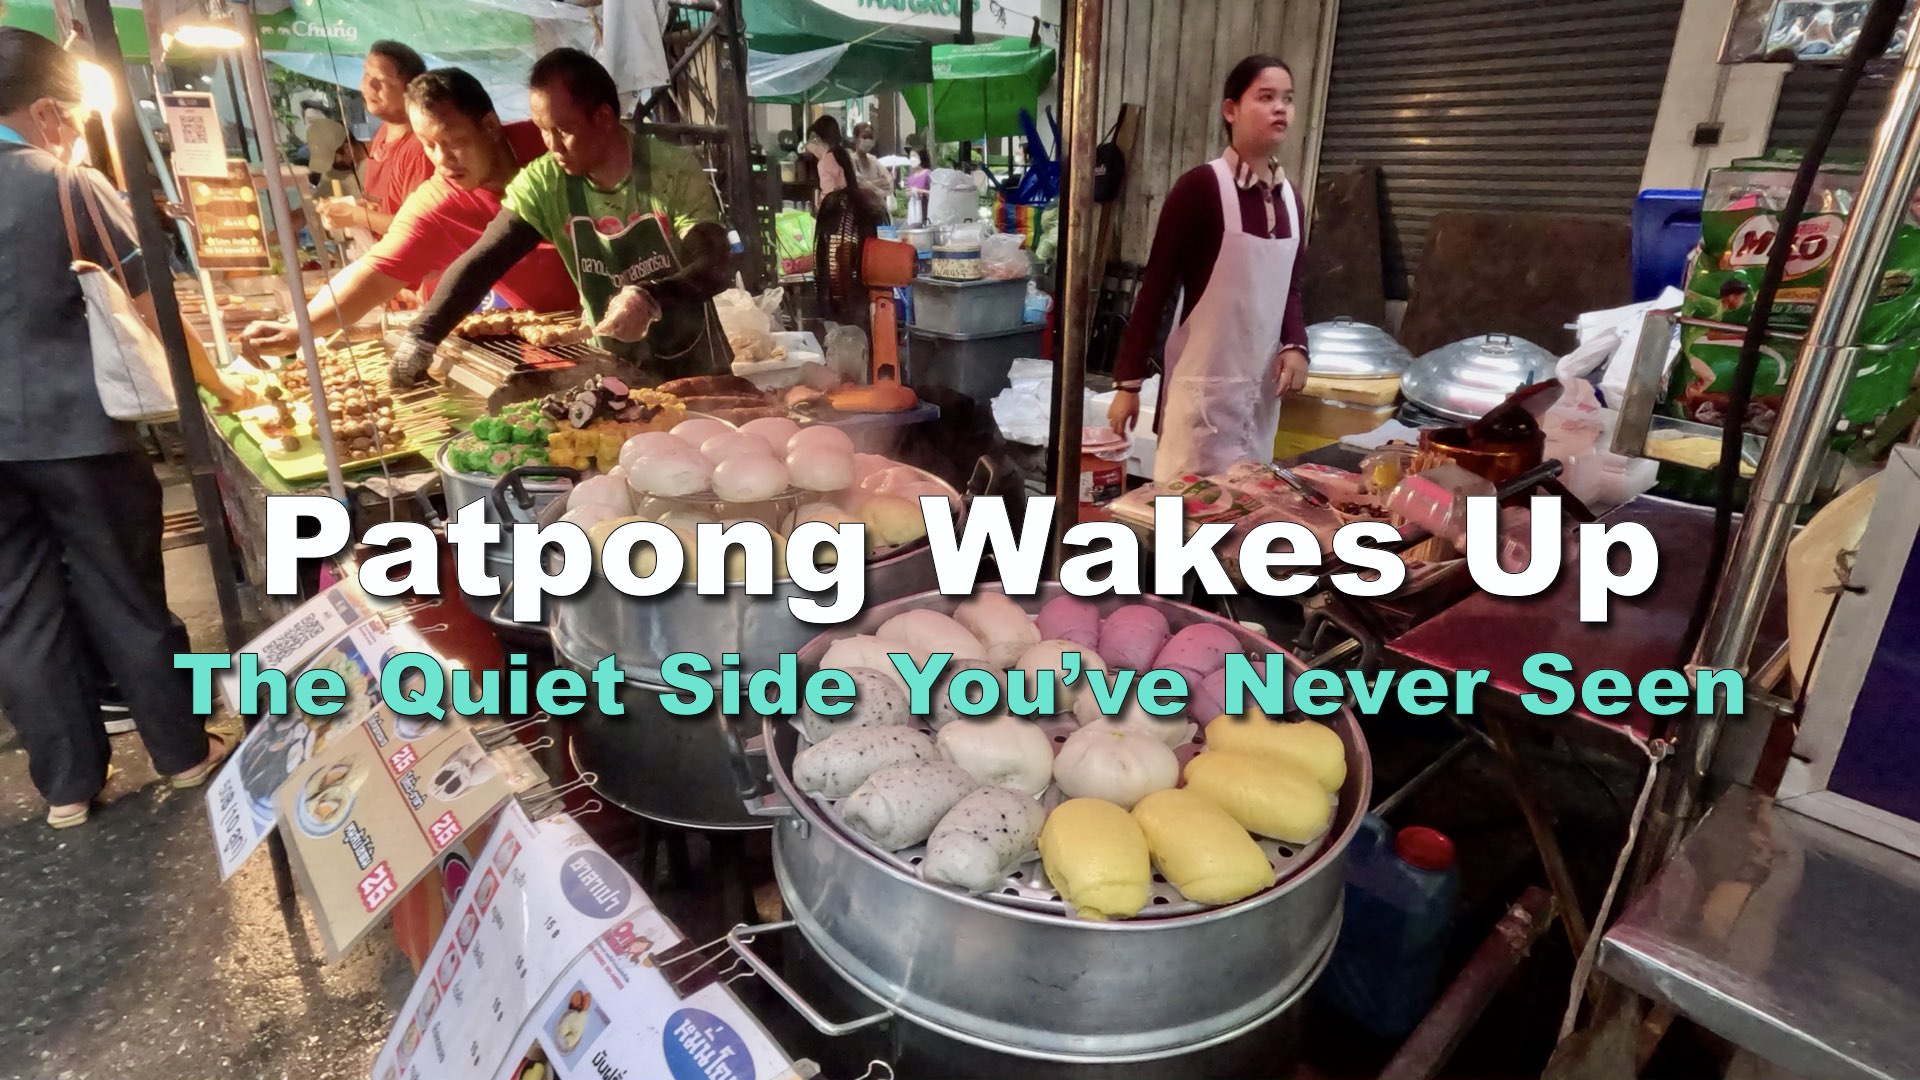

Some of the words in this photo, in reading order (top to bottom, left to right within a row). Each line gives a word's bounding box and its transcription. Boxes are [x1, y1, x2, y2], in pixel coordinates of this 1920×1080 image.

[291, 19, 358, 42] Chang
[390, 745, 417, 773] 25
[432, 813, 460, 847] 25
[360, 864, 395, 909] 25
[569, 856, 621, 913] ซาลาเปา
[543, 915, 557, 931] 15
[673, 1018, 738, 1080] หมั่นโถ
